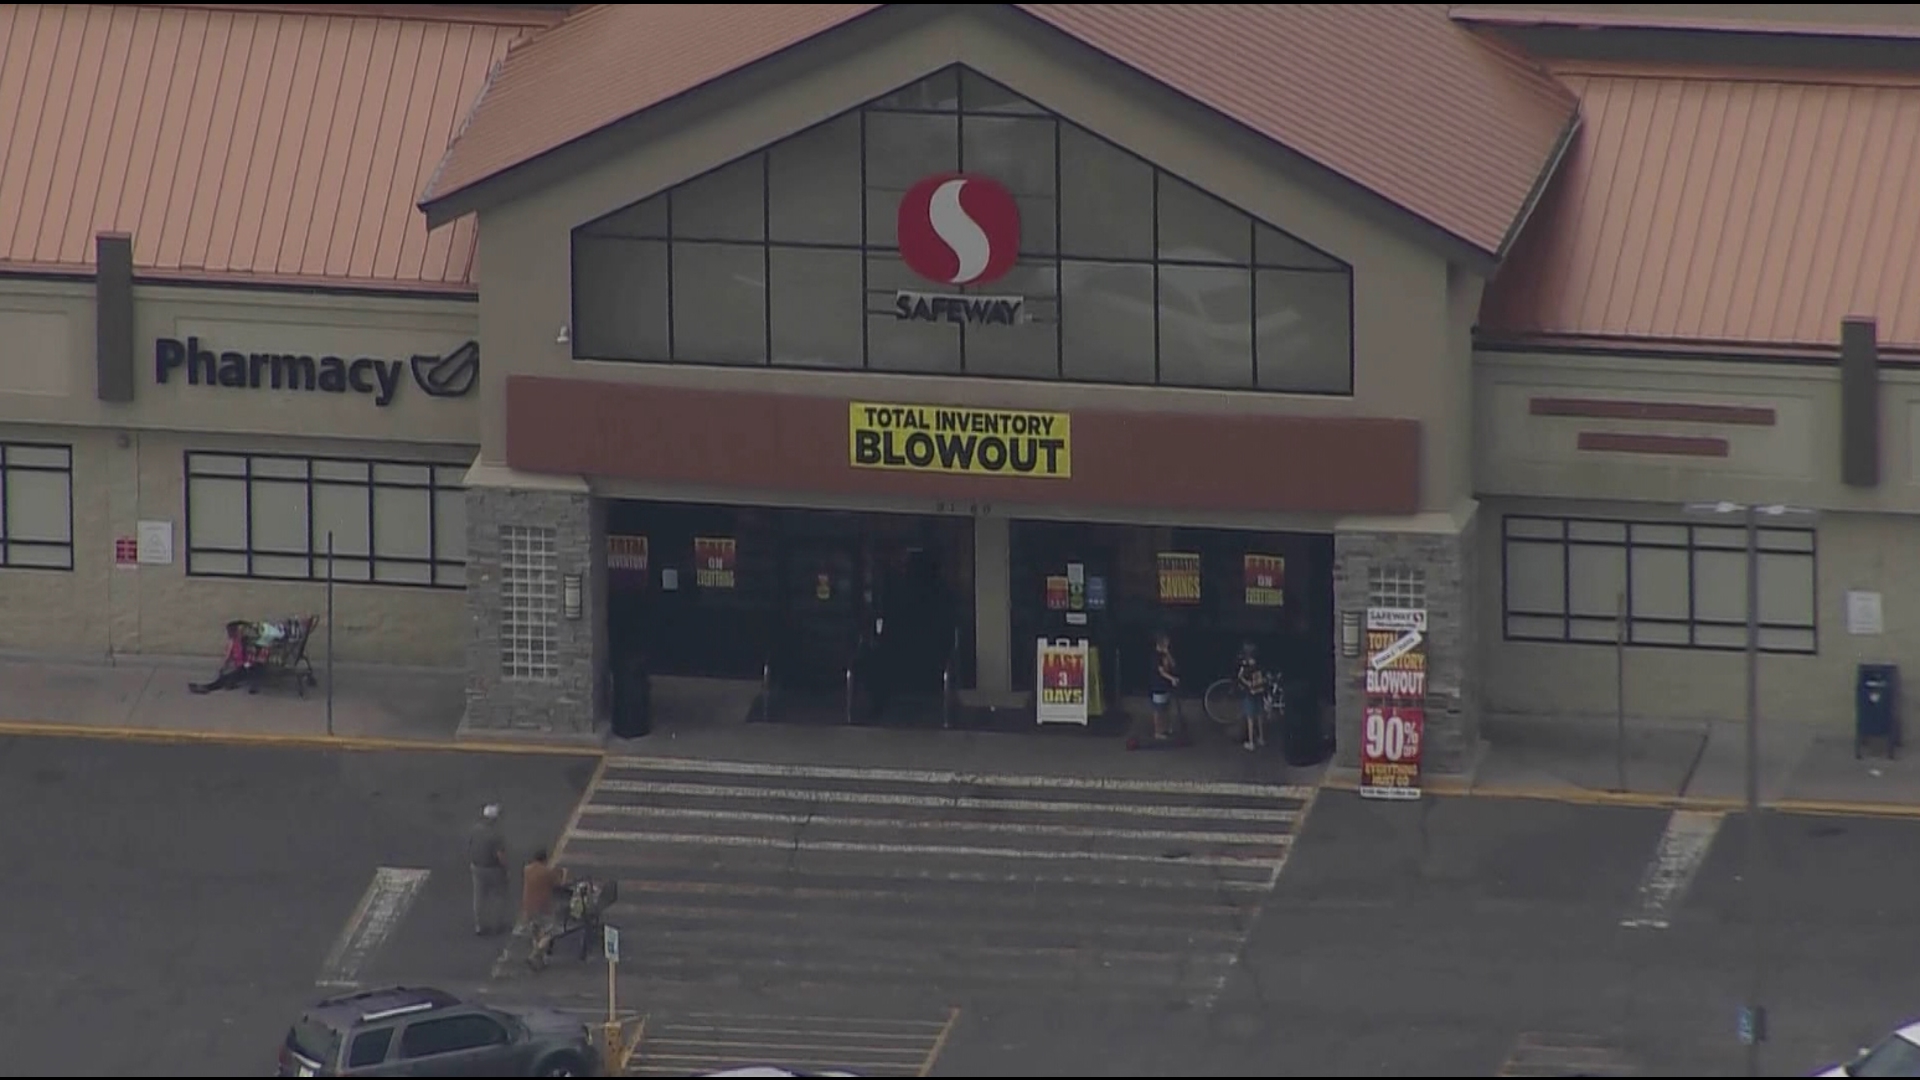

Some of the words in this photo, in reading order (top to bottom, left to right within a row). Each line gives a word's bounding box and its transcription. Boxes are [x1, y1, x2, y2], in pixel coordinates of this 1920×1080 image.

[896, 295, 1022, 325] SAFEWAY
[155, 336, 403, 407] Pharmacy
[864, 407, 930, 430] TOTAL
[935, 409, 1055, 436] INVENTORY
[855, 430, 1065, 474] BLOWOUT
[1160, 573, 1200, 598] SAVINGS
[1370, 611, 1411, 621] SAFEWAY
[1043, 653, 1083, 671] LAST
[1058, 671, 1069, 687] 3
[1367, 669, 1425, 695] BLOWOUT
[1043, 689, 1083, 704] DAYS
